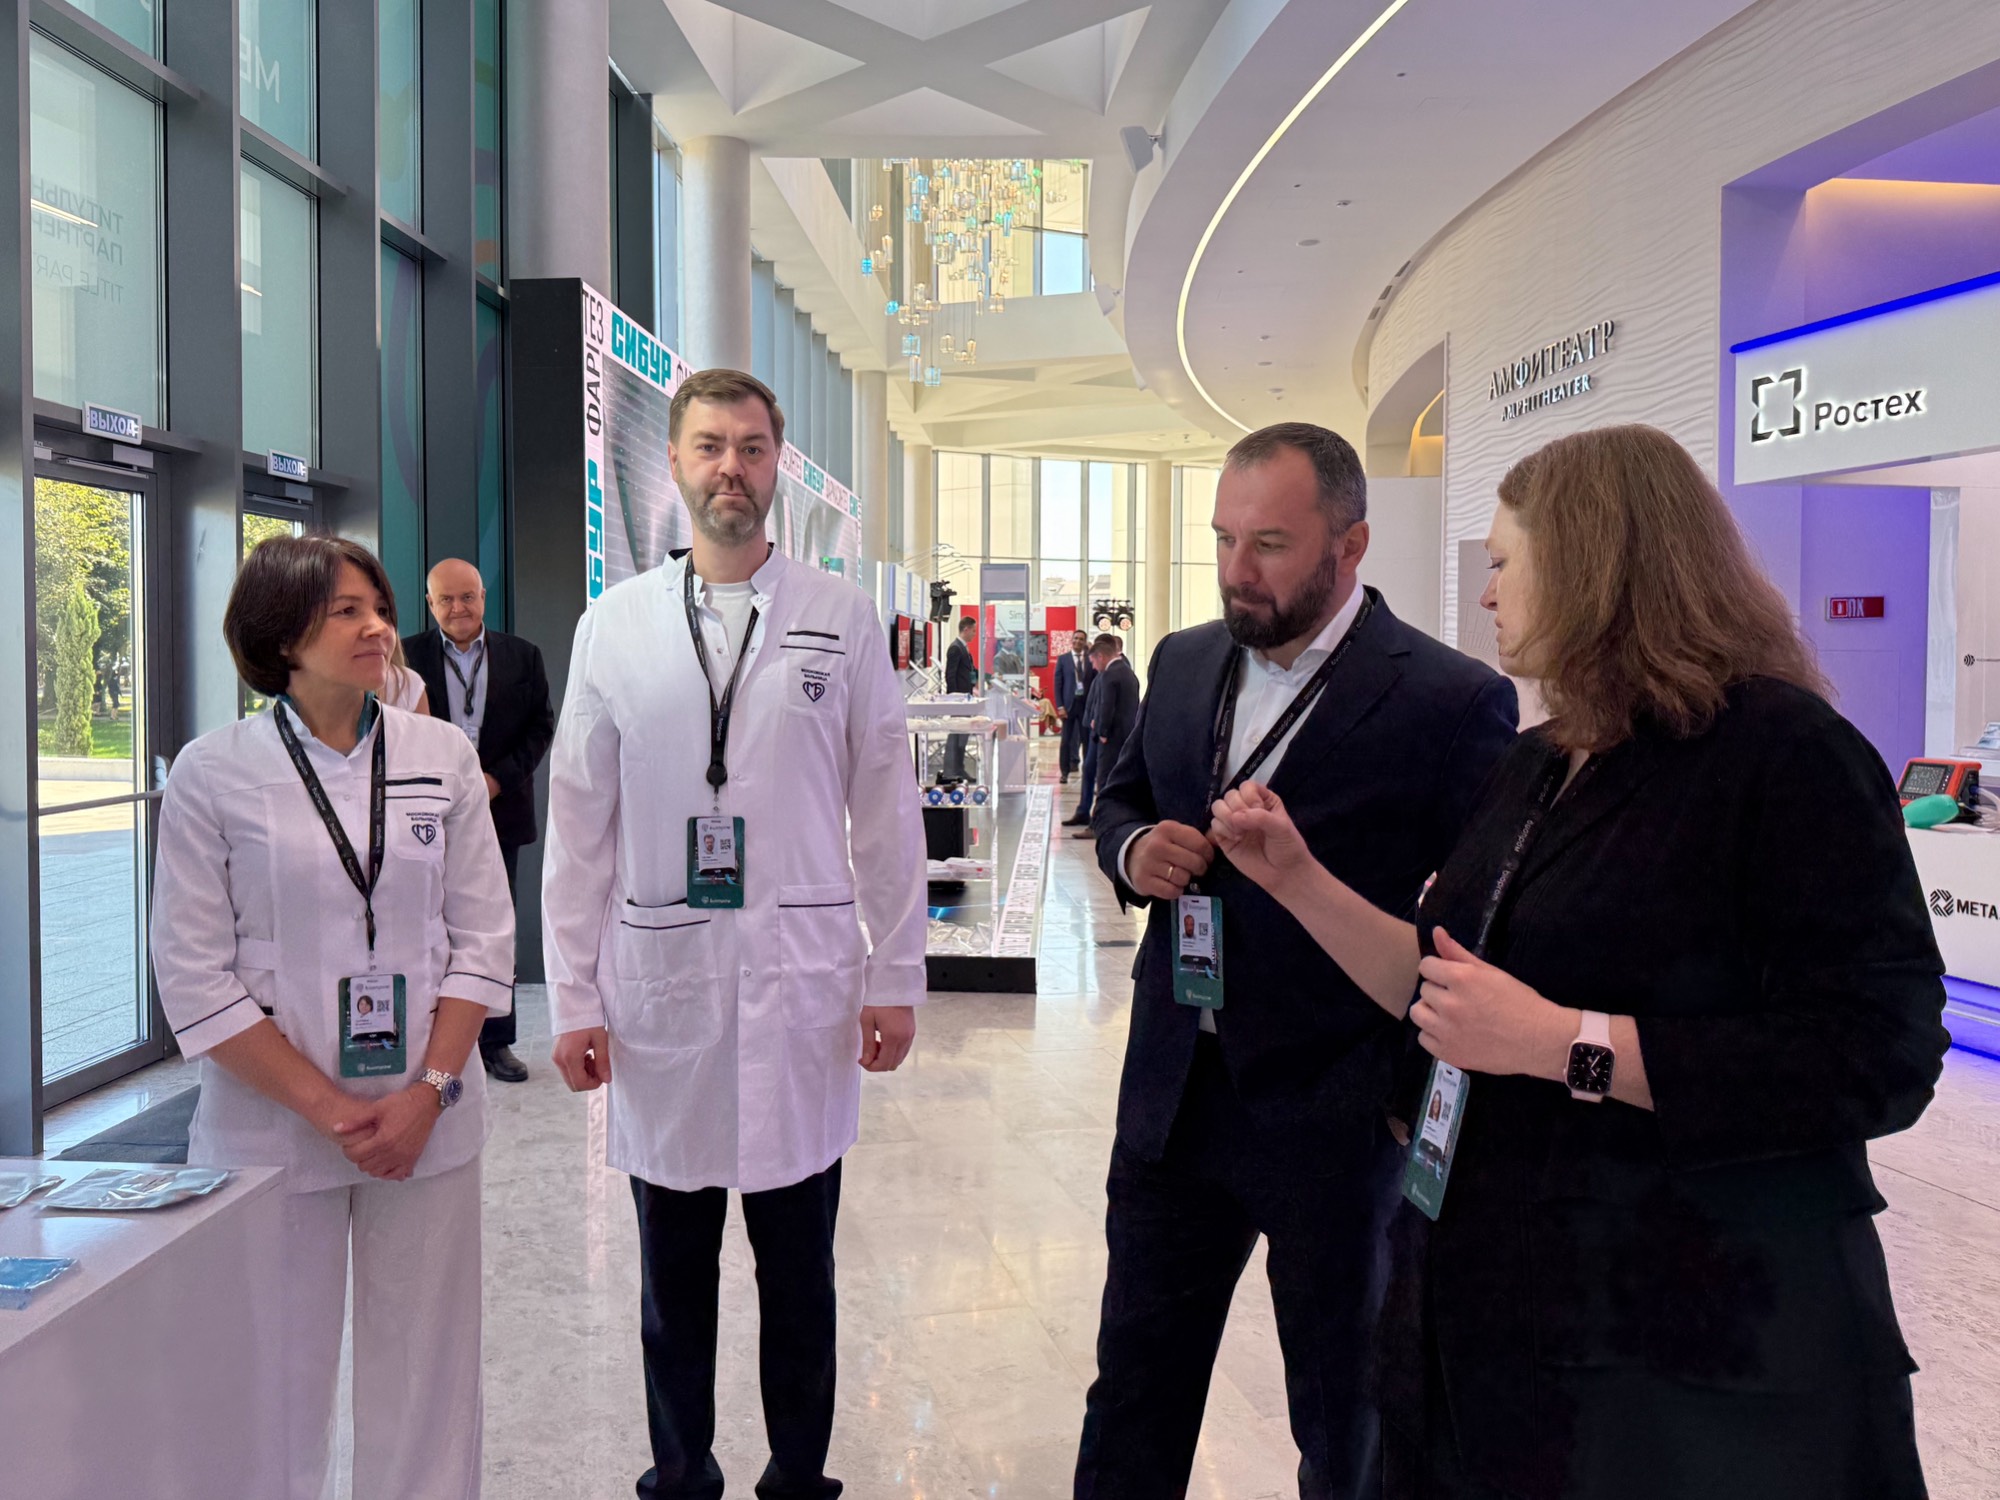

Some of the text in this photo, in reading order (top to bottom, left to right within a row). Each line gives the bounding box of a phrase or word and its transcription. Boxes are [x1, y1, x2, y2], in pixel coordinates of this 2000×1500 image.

[611, 310, 672, 389] СИБУР
[1487, 320, 1615, 401] АМФИТЕАТР
[1501, 373, 1593, 421] AMPHITHEATER
[1814, 390, 1923, 431] Ростех
[90, 409, 136, 437] ВЫХОД
[272, 455, 305, 476] ВЫХОД
[1492, 869, 1510, 901] bioprom
